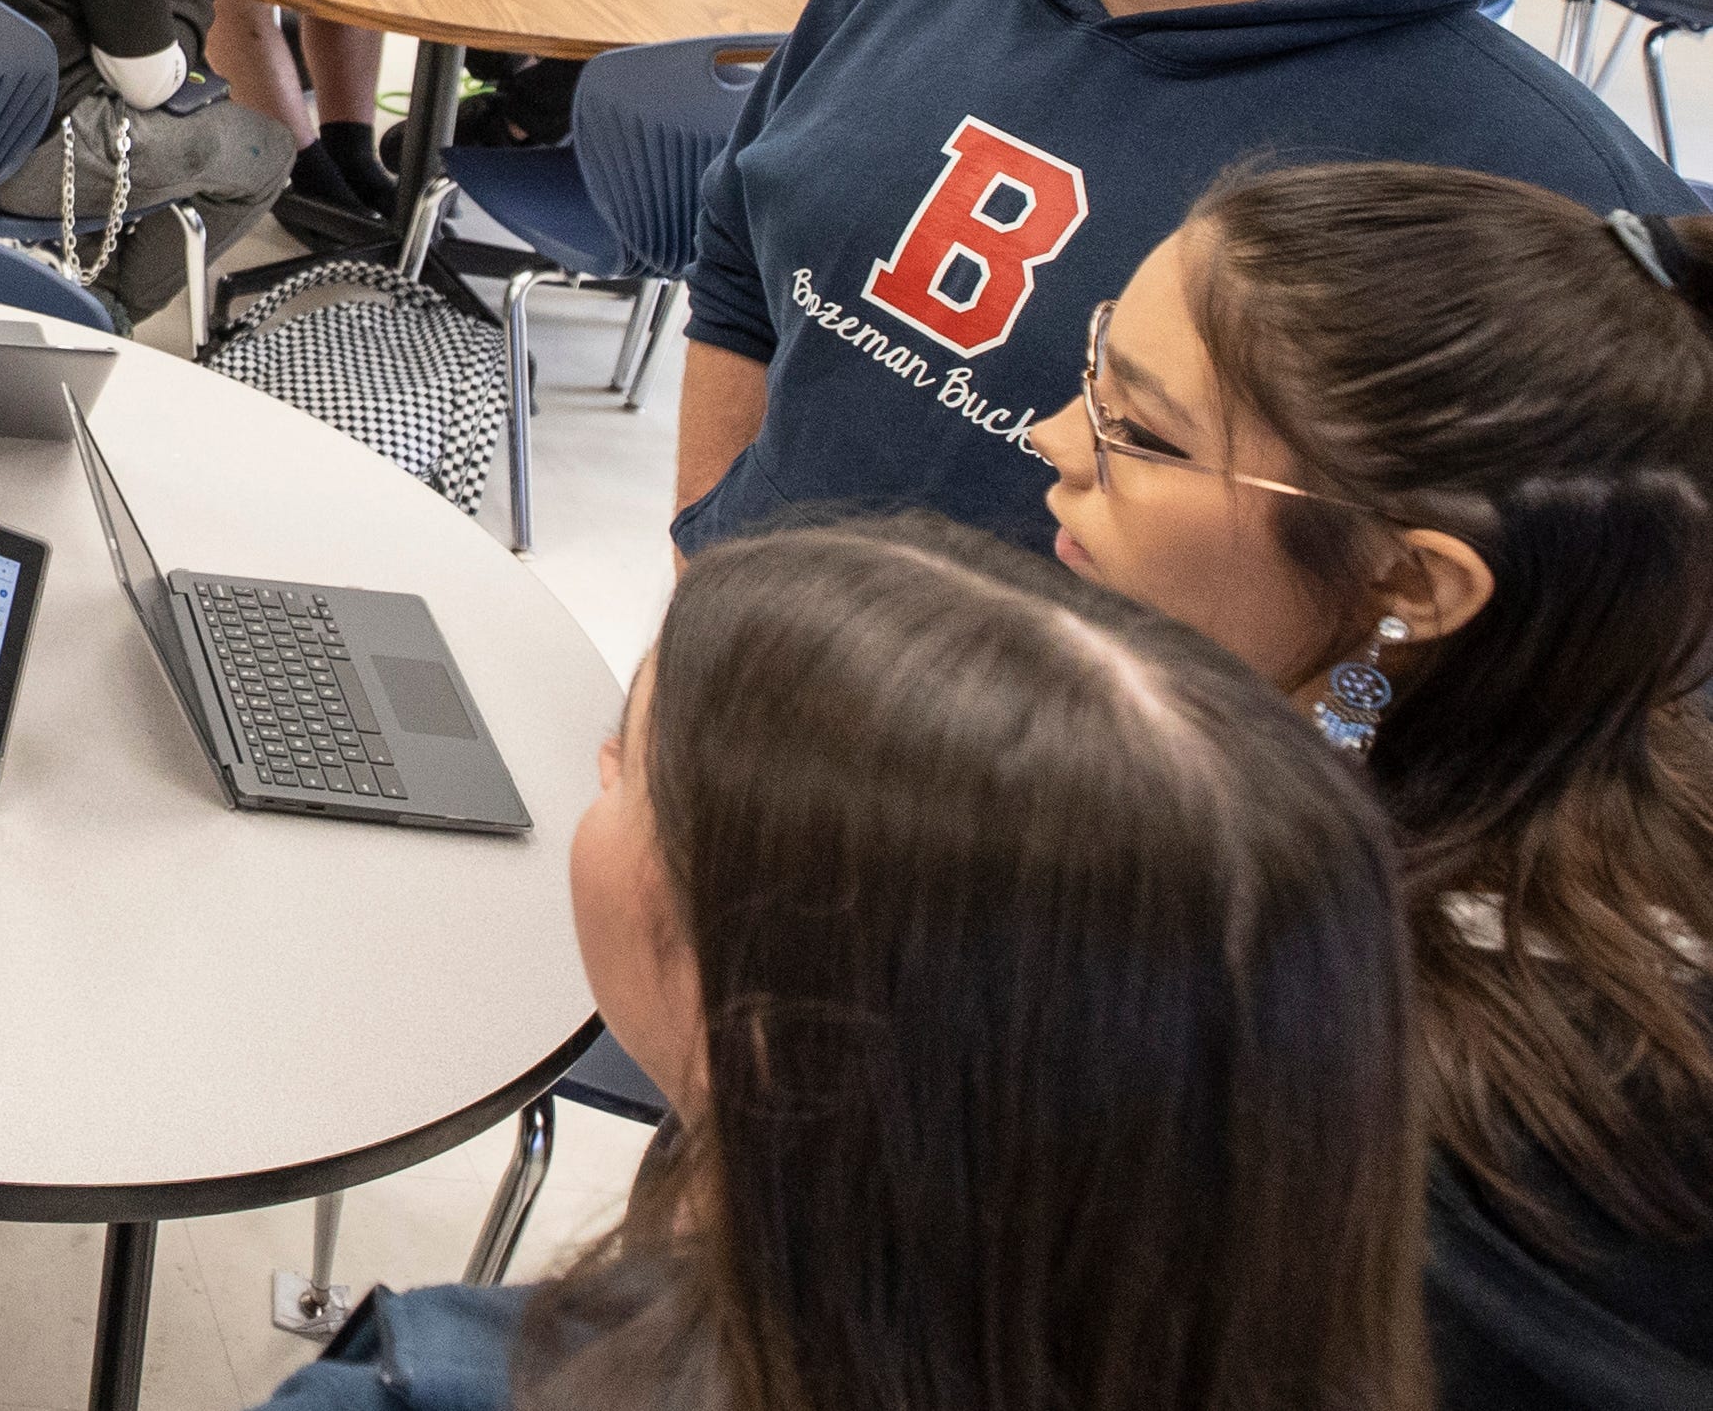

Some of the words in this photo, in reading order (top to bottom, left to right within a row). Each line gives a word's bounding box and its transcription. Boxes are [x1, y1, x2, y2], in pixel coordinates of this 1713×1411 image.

[861, 114, 1089, 359] B
[791, 268, 937, 388] Bozeman
[936, 367, 1055, 467] Buck
